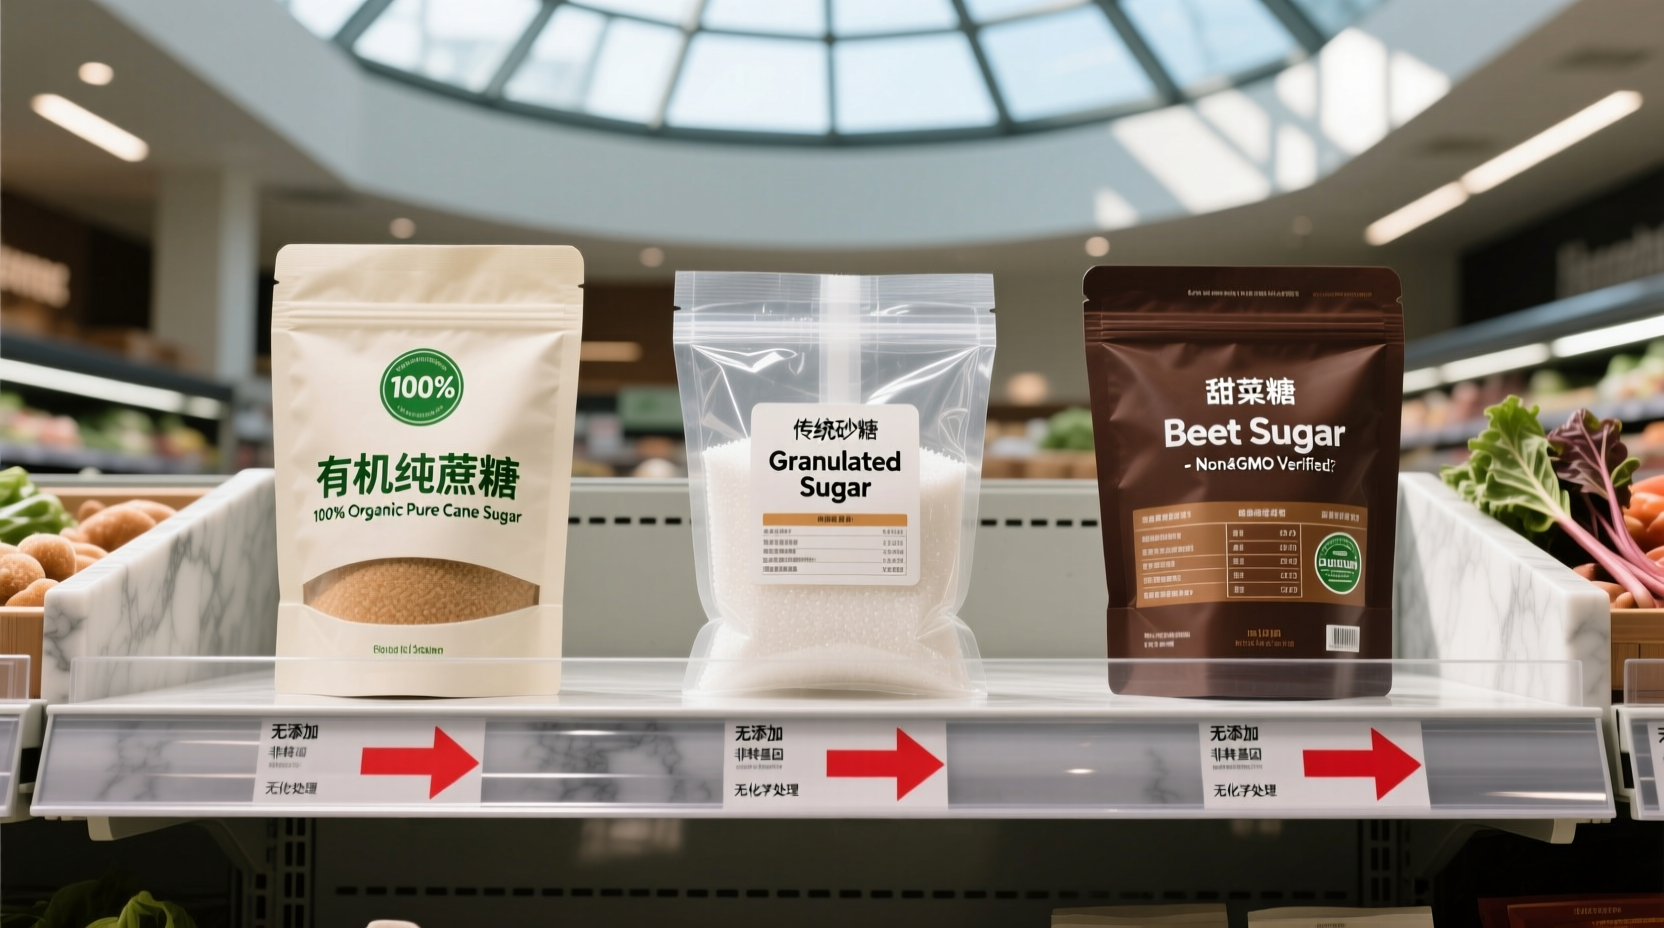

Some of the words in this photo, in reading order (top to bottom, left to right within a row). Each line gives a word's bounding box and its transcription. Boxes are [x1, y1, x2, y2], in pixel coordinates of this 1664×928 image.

[391, 375, 456, 399] 100%
[1205, 376, 1296, 406] 甜菜糖
[793, 417, 879, 441] 传统砂糖
[1164, 418, 1242, 448] Beet
[1250, 416, 1346, 454] Sugar
[769, 450, 901, 472] Granulated
[316, 452, 520, 500] 有机纯蔗糖
[800, 476, 872, 504] Sugar
[313, 505, 345, 523] 100%
[348, 502, 404, 521] Organic
[406, 502, 440, 516] Pure
[443, 503, 480, 518] Cane
[483, 505, 523, 525] Sugar
[271, 723, 319, 740] 无添加
[735, 724, 783, 742] 无添加
[1210, 724, 1259, 742] 无添加
